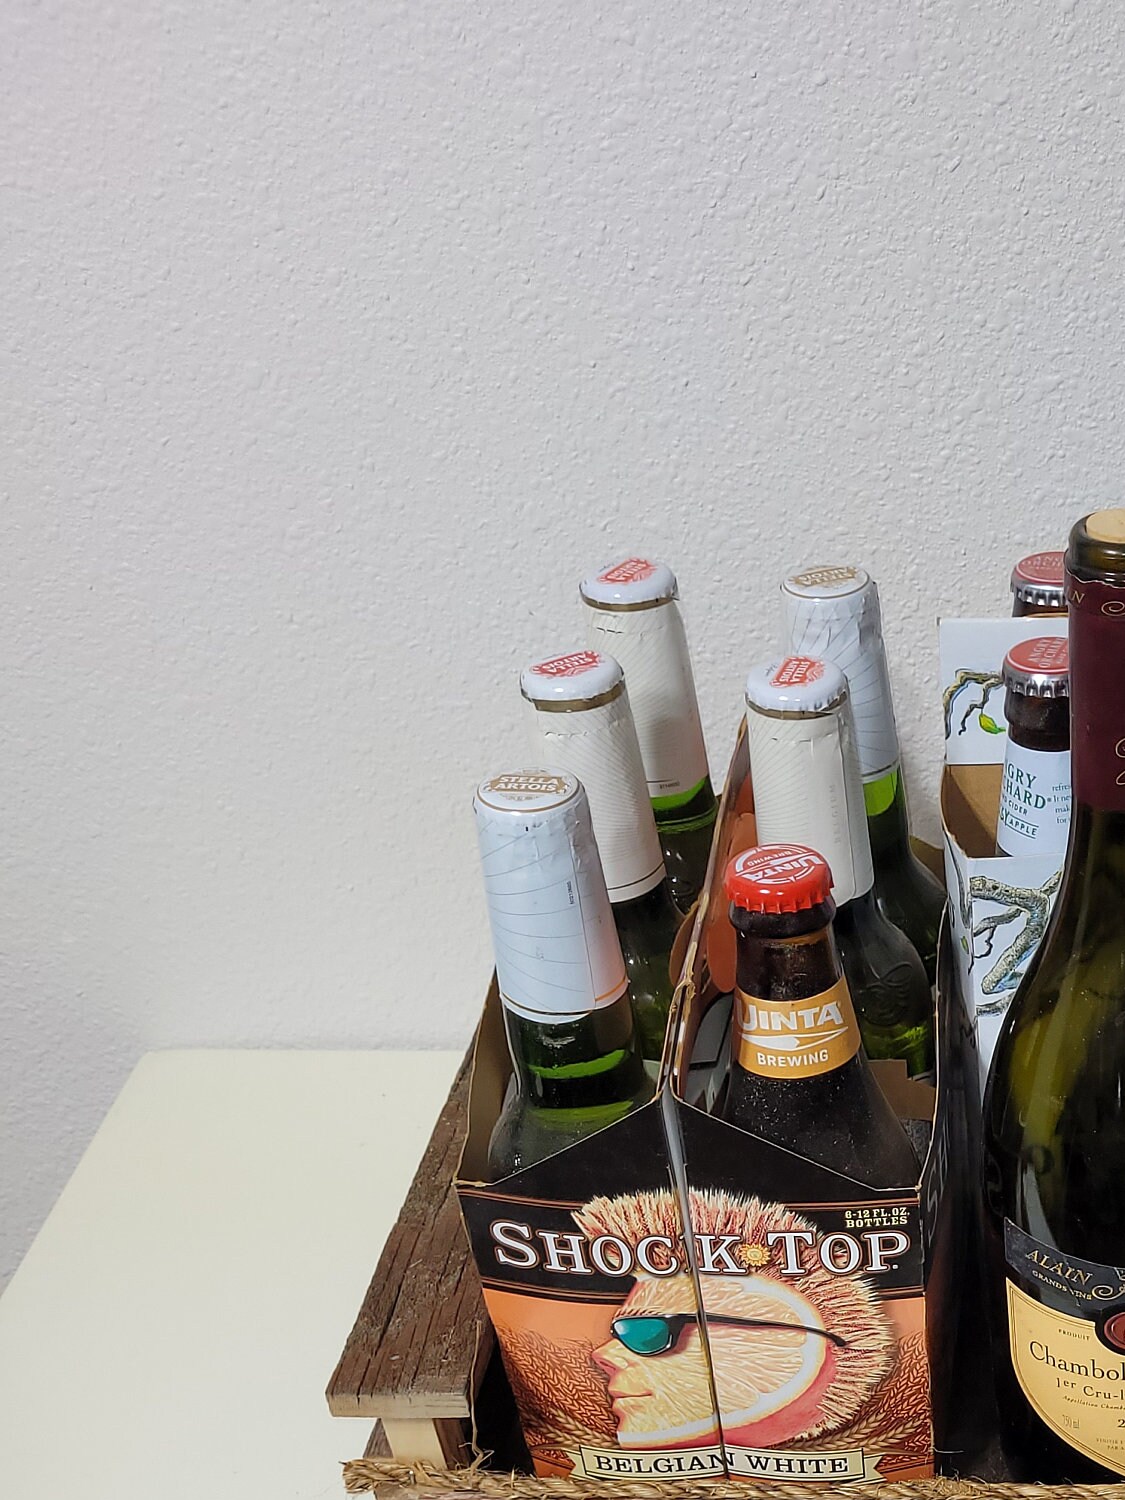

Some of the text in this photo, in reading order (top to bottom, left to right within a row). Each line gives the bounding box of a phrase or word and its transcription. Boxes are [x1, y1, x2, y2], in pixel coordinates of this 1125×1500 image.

[500, 776, 559, 785] STELLA
[1006, 760, 1037, 789] GRY
[495, 783, 556, 791] ARTOIS
[1004, 778, 1046, 809] HARD
[1009, 800, 1028, 815] CIDER
[1009, 819, 1038, 836] APPLE
[747, 850, 793, 867] BREWING
[741, 855, 825, 882] UINTA
[757, 1049, 829, 1067] BREWING
[845, 1209, 870, 1219] 6-12
[846, 1216, 908, 1228] BOTTLES
[491, 1221, 910, 1278] SHOCK TOP
[1025, 1249, 1093, 1286] ALAIN
[1032, 1270, 1068, 1292] GRANDS
[1058, 1328, 1090, 1341] PRODUIT
[1057, 1378, 1077, 1389] 1er
[594, 1451, 849, 1474] BELGIAN WHITE
